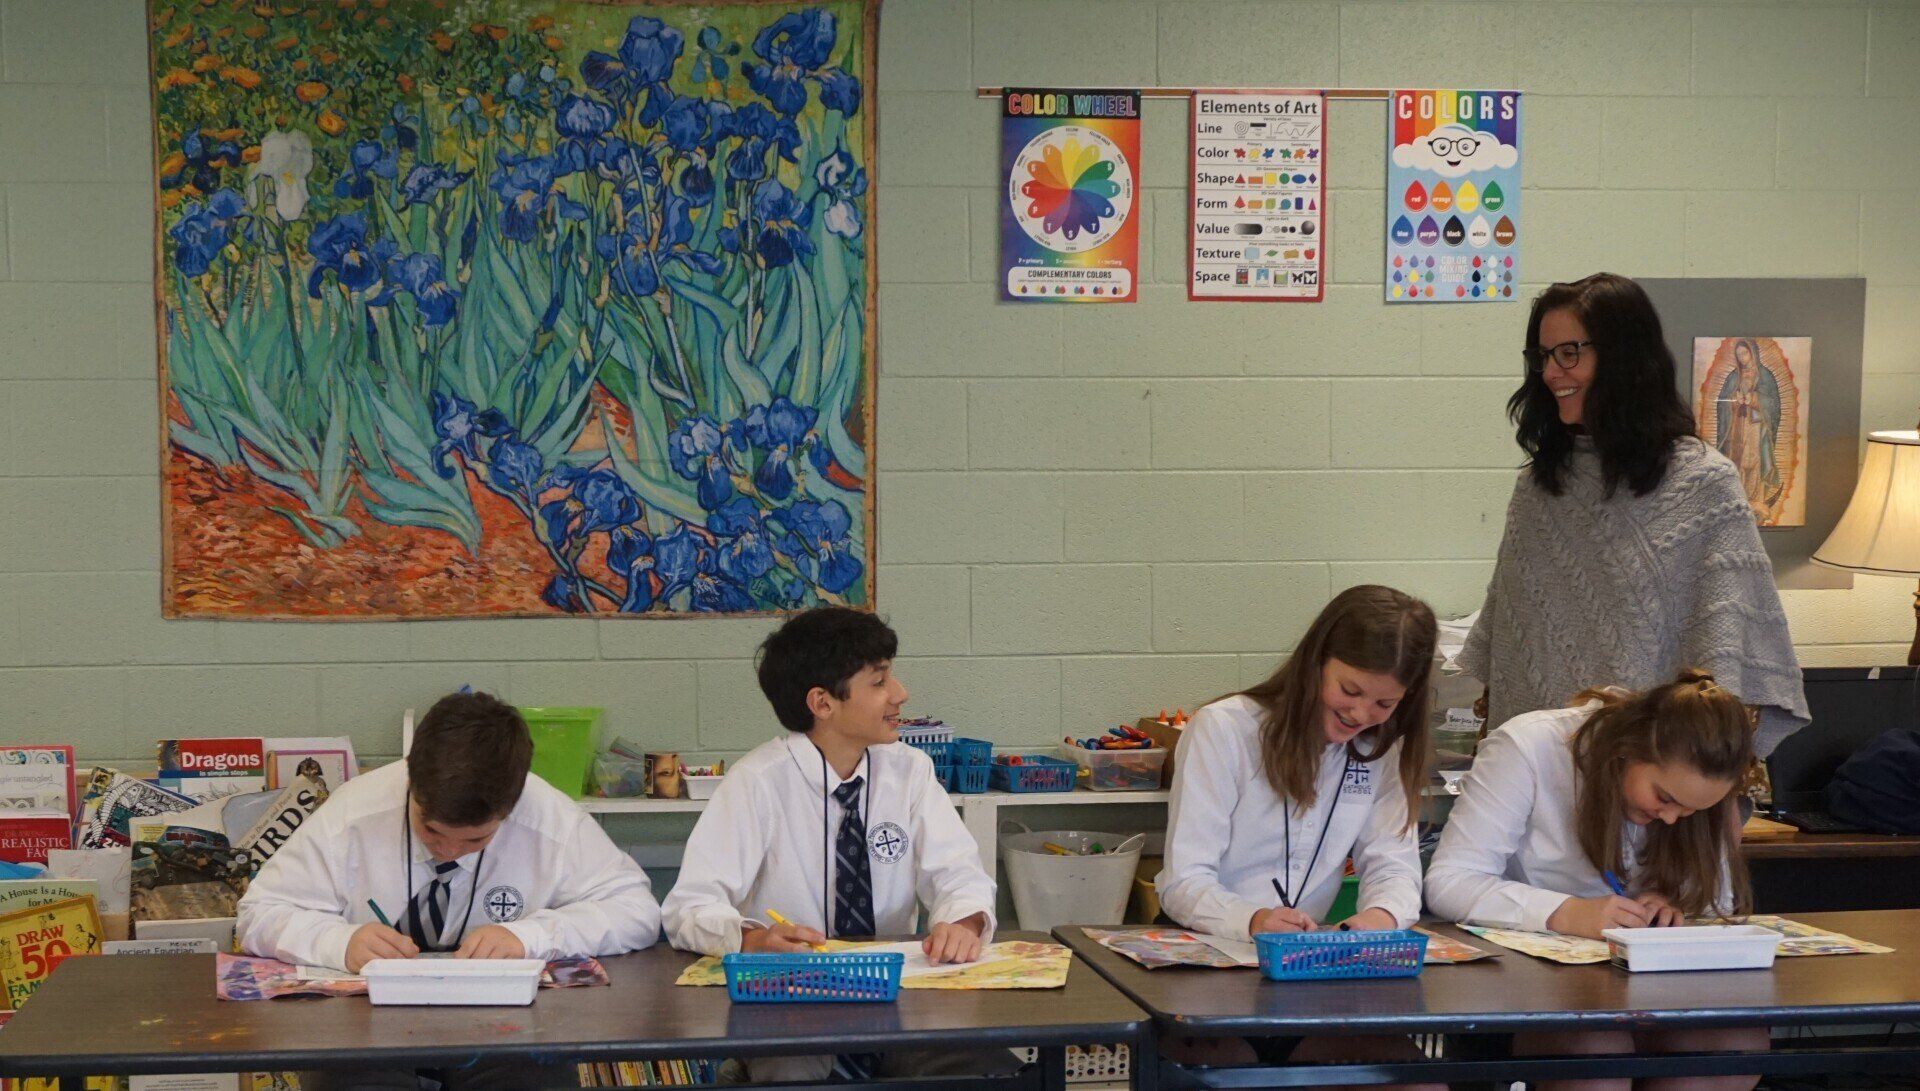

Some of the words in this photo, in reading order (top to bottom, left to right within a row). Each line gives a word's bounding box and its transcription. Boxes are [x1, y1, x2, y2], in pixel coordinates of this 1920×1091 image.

[1008, 94, 1068, 115] COLOR
[1073, 94, 1136, 116] WHEEL
[1201, 100, 1270, 113] Elements
[1274, 100, 1290, 113] of
[1294, 101, 1317, 114] Art
[1399, 95, 1514, 120] COLORS
[1198, 124, 1222, 133] Line
[1198, 147, 1229, 158] Color
[1198, 172, 1234, 186] Shape
[1197, 198, 1228, 208] Form
[1485, 196, 1500, 204] green
[1196, 224, 1230, 234] Value
[1196, 248, 1241, 258] Texture
[1028, 270, 1085, 278] COMPLEMENTARY
[1087, 271, 1112, 279] COLORS
[1196, 271, 1230, 283] Space
[182, 752, 260, 770] Dragons
[1346, 774, 1353, 782] P
[1362, 774, 1368, 782] H
[2, 838, 68, 848] REALISTIC
[26, 848, 48, 858] FAC
[8, 887, 38, 900] House
[41, 886, 49, 894] Is
[28, 898, 42, 907] for
[16, 924, 64, 946] DRAW
[21, 940, 71, 980] 50
